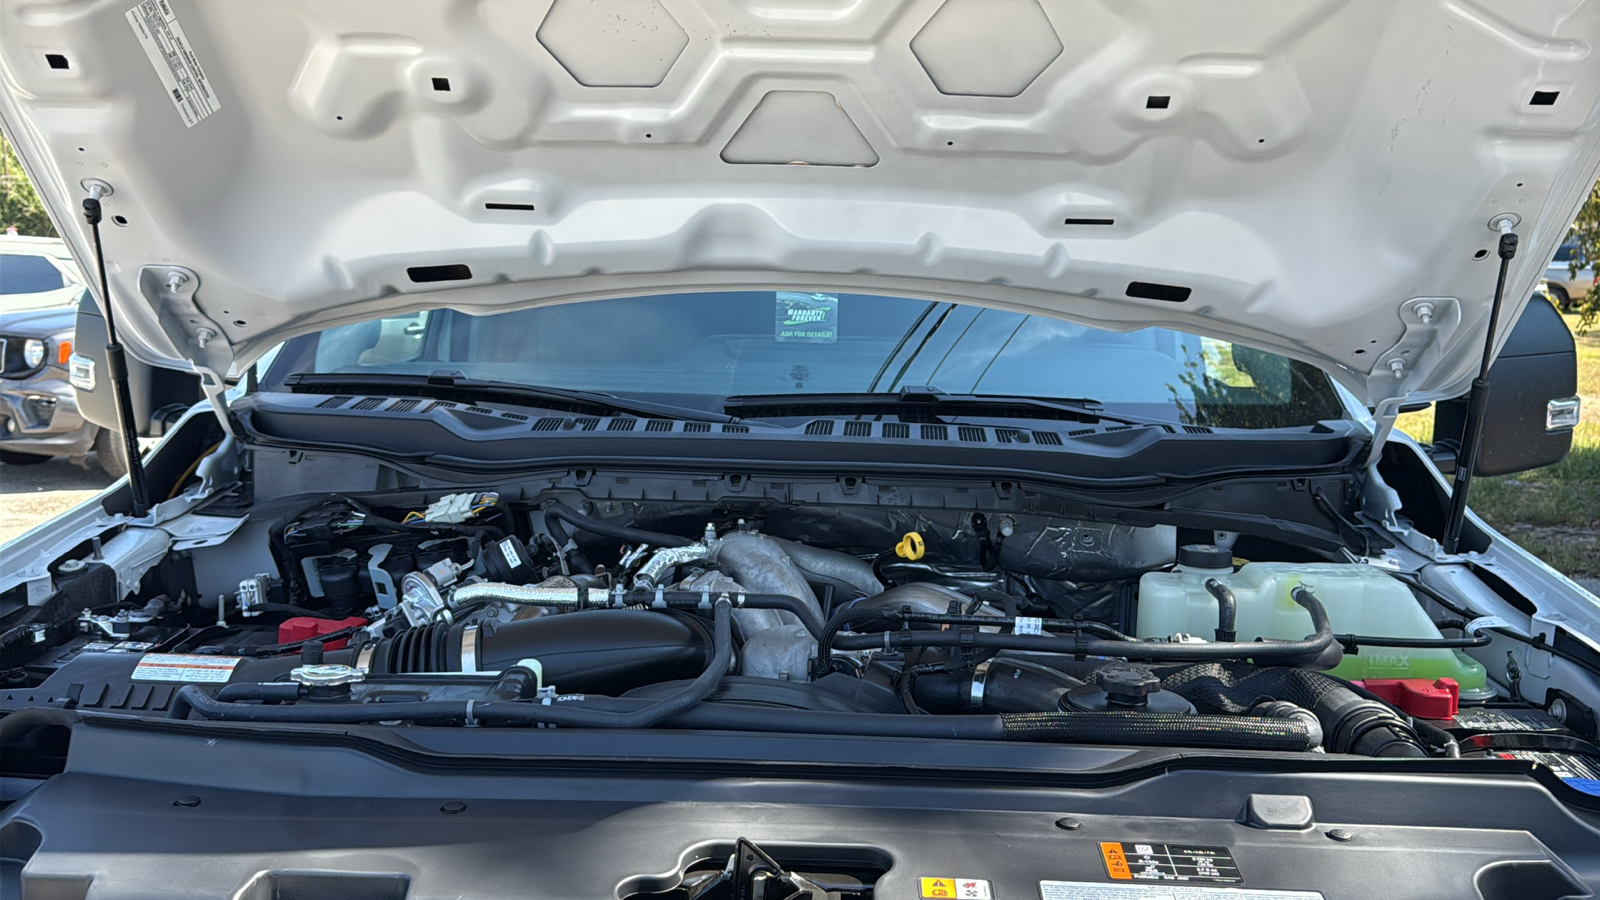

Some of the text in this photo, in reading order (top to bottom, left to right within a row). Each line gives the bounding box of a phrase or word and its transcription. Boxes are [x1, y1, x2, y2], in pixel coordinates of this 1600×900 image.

[176, 36, 210, 98] VEHICLE EMISSION CONTROL INFORMATION
[1375, 654, 1410, 666] MAX
